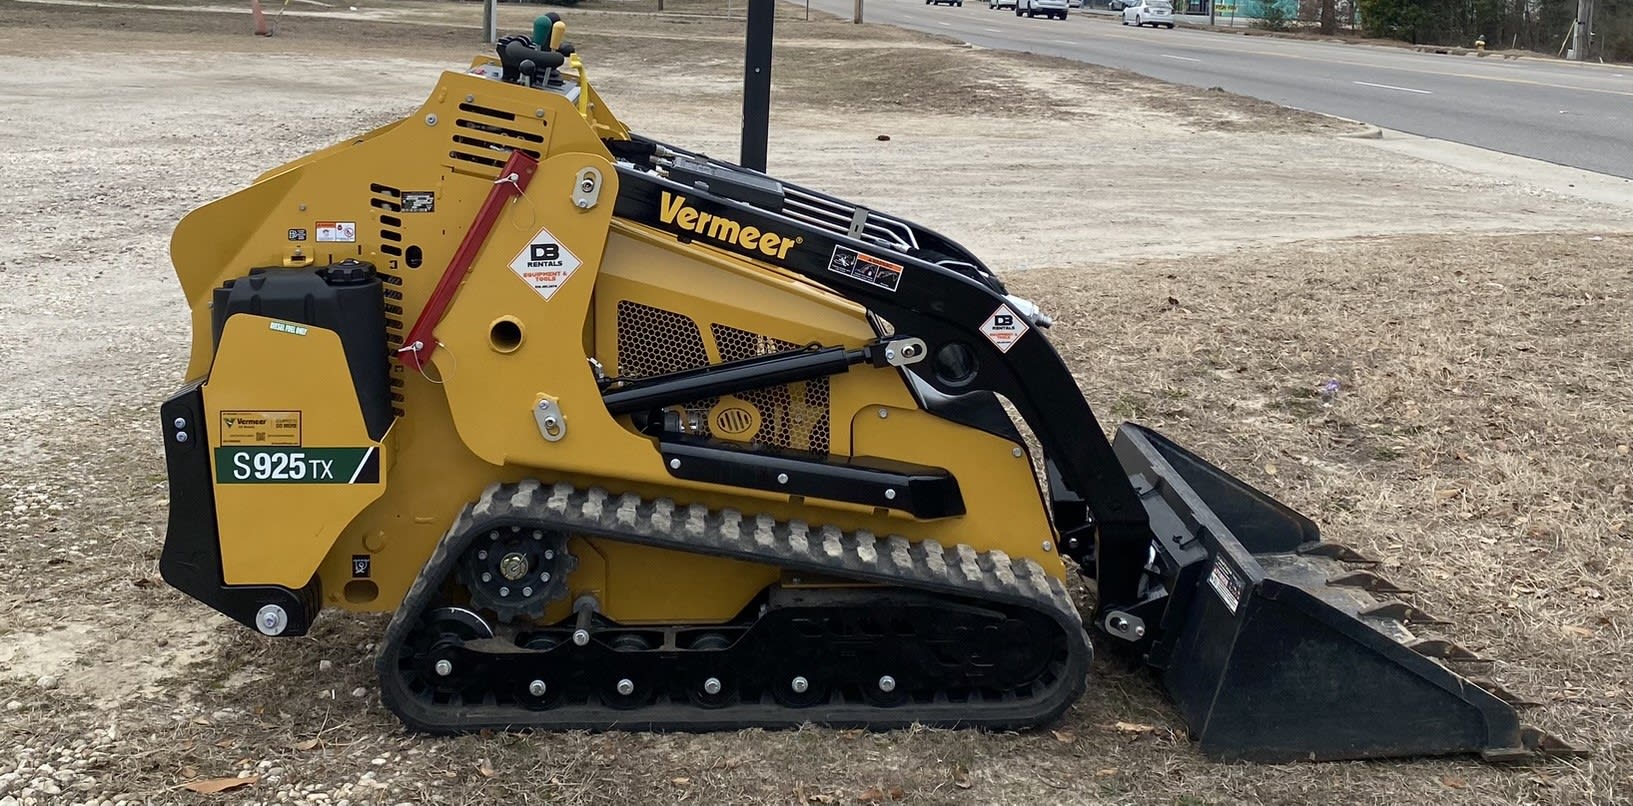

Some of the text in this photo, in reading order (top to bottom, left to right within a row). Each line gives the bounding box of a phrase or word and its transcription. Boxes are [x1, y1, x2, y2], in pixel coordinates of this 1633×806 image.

[660, 190, 795, 260] Vermeer
[530, 243, 559, 261] DB
[995, 315, 1013, 326] DB
